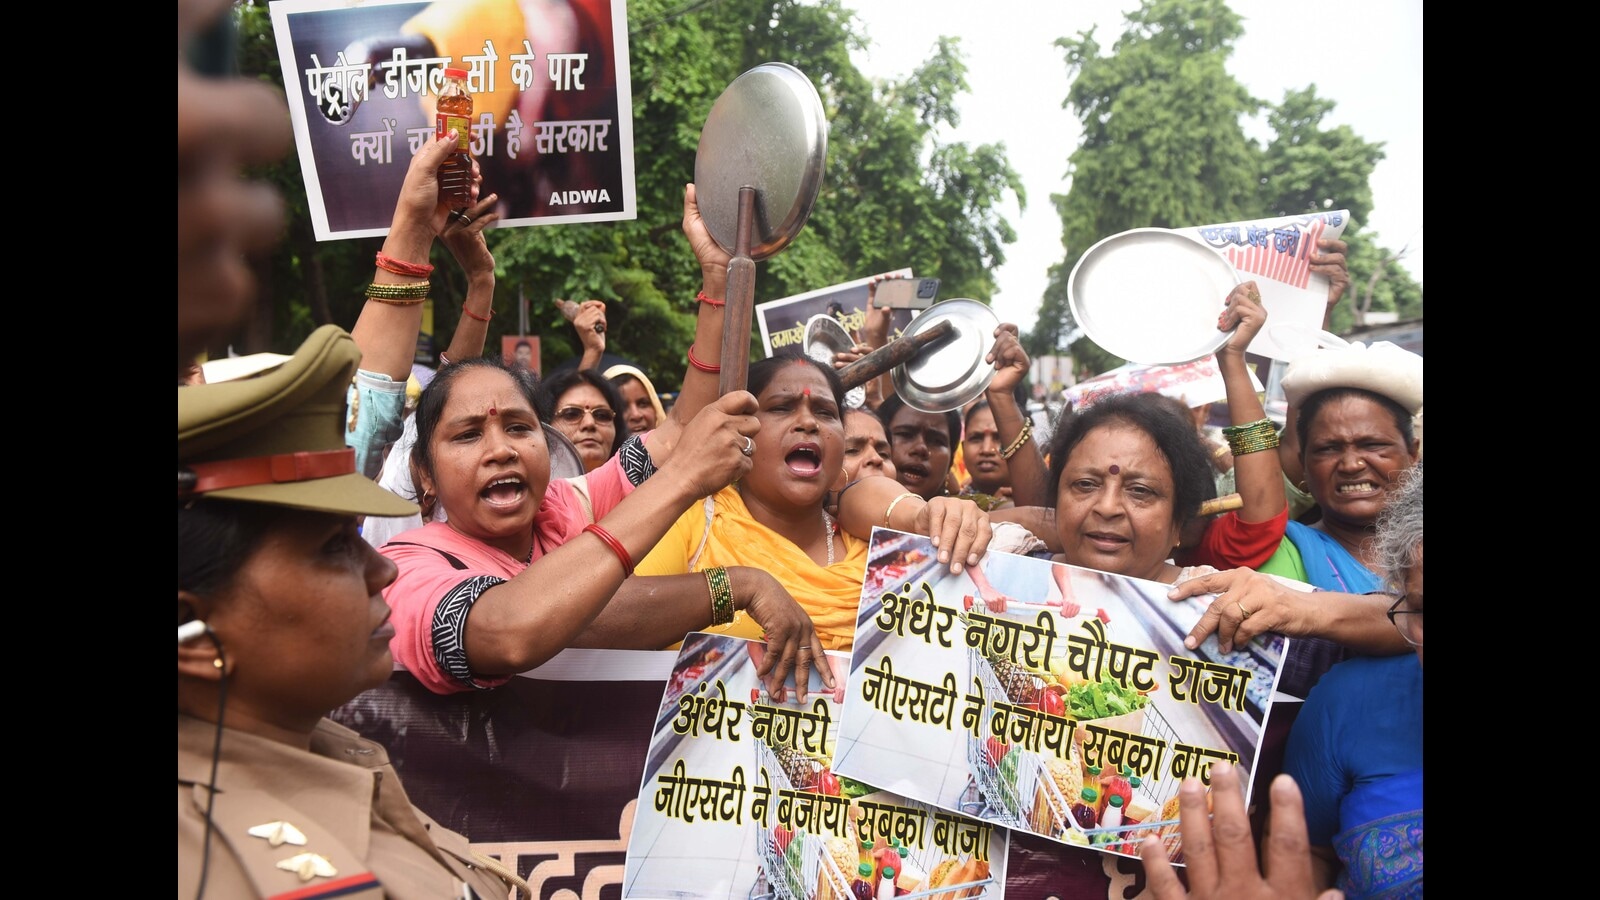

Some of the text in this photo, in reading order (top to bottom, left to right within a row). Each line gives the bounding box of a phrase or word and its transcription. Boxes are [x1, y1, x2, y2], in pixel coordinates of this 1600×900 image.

[305, 39, 588, 116] पेट्रोल डीजल सौ के पार
[350, 118, 397, 165] क्यों
[505, 110, 523, 159] है
[534, 119, 612, 154] सरकार
[549, 189, 611, 206] AIDWA
[876, 582, 1252, 712] अंधेर नगरी चौपट राजा
[673, 680, 831, 755] अंधेर नगरी
[862, 656, 958, 731] जीएसटी
[962, 677, 985, 738] ने
[991, 702, 1078, 761] बजाया
[1082, 723, 1166, 781] सबका
[655, 759, 994, 862] जीएसटी ने बजाया सबका बाजा
